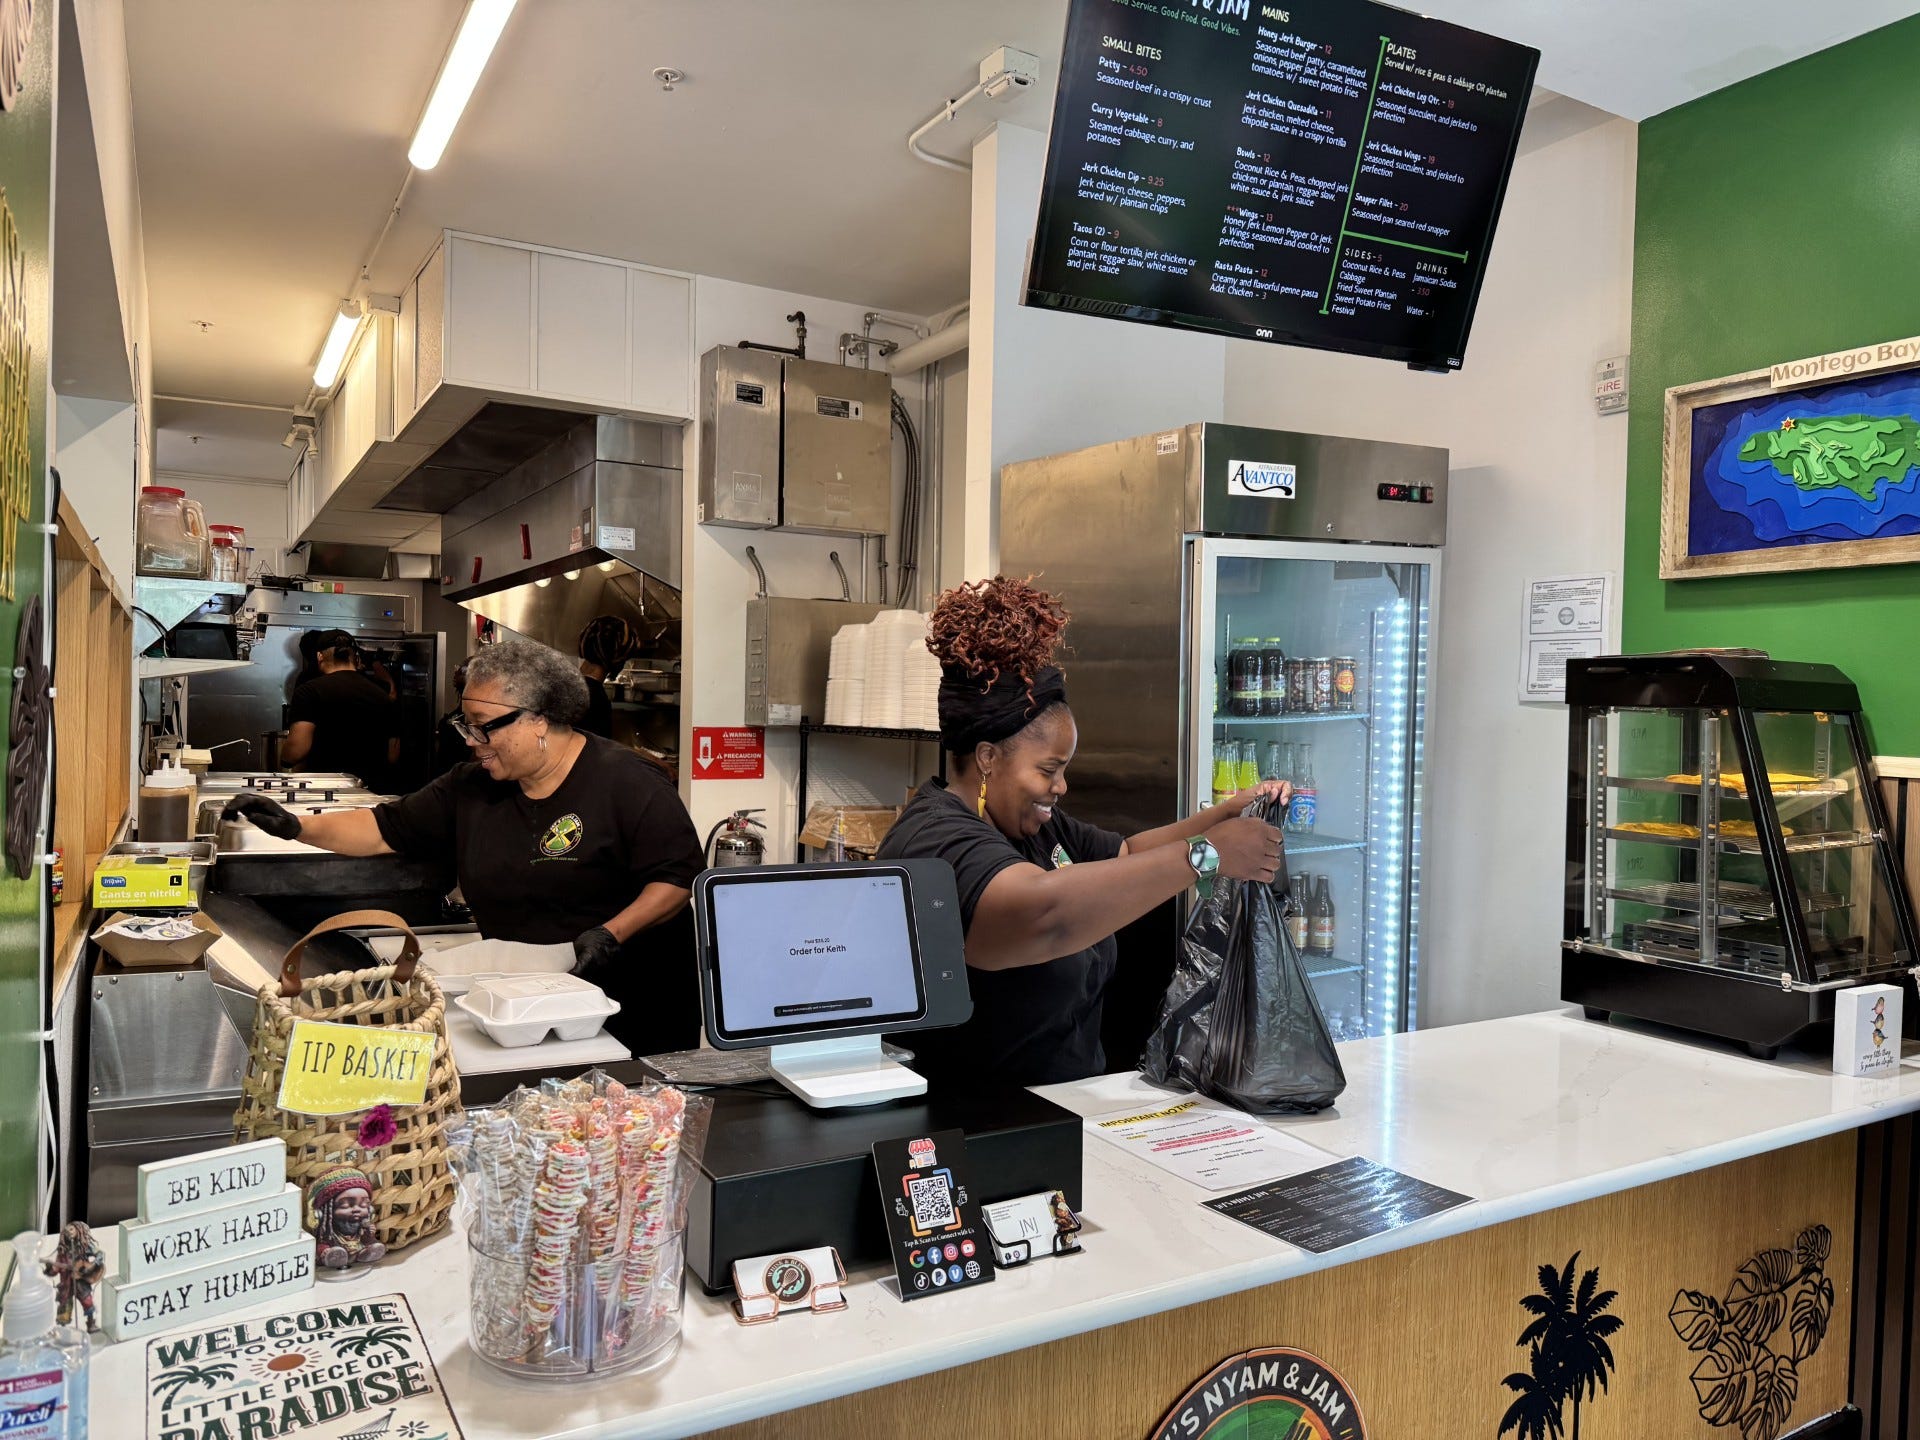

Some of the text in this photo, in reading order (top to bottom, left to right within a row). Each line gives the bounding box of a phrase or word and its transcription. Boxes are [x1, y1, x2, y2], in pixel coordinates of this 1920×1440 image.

[1161, 6, 1179, 20] Good
[1181, 10, 1198, 24] Food.
[1201, 16, 1220, 30] Good
[1221, 22, 1240, 36] Vibes.
[1261, 6, 1290, 23] MAINS
[1102, 36, 1162, 61] SMALL BITES
[1258, 26, 1278, 42] Honey
[1278, 32, 1294, 44] Jerk
[1295, 36, 1318, 51] Burger
[1386, 43, 1417, 60] PLATES
[1098, 56, 1148, 76] Patty 4.50
[1096, 72, 1212, 108] Seasoned beef in a crispy crust
[1245, 90, 1261, 101] Jerk
[1262, 93, 1286, 108] Chicken
[1091, 102, 1114, 118] Curry
[1115, 107, 1149, 124] Vegetable
[1086, 132, 1121, 146] potatoes
[1089, 118, 1195, 151] Steamed cabbage, curry, and
[1236, 146, 1271, 162] Bowls 12
[1366, 140, 1380, 151] Jerk
[1380, 143, 1403, 157] Chicken
[1404, 149, 1421, 162] Wings
[1082, 162, 1164, 187] Jerk Chicken Dip 9.25
[1077, 189, 1168, 214] served w/ plantain chips
[1079, 176, 1186, 207] Jerk chicken, cheese, peppers,
[1354, 192, 1378, 206] Snapper
[1399, 202, 1409, 211] 20
[1072, 221, 1120, 239] Tacos (2) 9
[1351, 208, 1451, 236] Seasoned pan seared red snapper
[1068, 246, 1188, 276] plantain, reggae slaw, white sauce
[1070, 236, 1089, 247] Corn
[1101, 241, 1118, 252] flour
[1120, 246, 1143, 258] tortilla,
[1144, 249, 1159, 260] jerk
[1160, 252, 1187, 265] chicken
[1188, 258, 1197, 267] or
[1066, 259, 1120, 275] and jerk sauce
[1214, 260, 1268, 277] Rasta Pasta 12
[1339, 271, 1366, 284] Cabbage
[1416, 261, 1448, 275] DRINKS
[1336, 282, 1398, 300] Fried Sweet Plantain
[1412, 273, 1457, 289] Jamaican Sodas
[1331, 304, 1356, 316] Festival
[1334, 293, 1392, 311] Sweet Potato Fries
[1772, 342, 1920, 382] Montego Bay
[1597, 380, 1621, 393] FIRE
[100, 890, 131, 899] Gants
[150, 888, 181, 897] nitrile
[790, 945, 846, 956] Order for Keith
[302, 1041, 420, 1080] TIP BASKET
[1098, 1112, 1162, 1128] IMPORTANT
[1162, 1101, 1200, 1117] NOTICE
[168, 1162, 266, 1206] BE KIND
[143, 1208, 288, 1264] WORK HARD
[937, 1232, 957, 1240] Connect
[123, 1254, 309, 1326] STAY HUMBLE
[155, 1302, 402, 1370] WELCOME
[228, 1331, 337, 1360] TO OUR
[162, 1351, 394, 1428] LITTLE PIECE OF
[1202, 1361, 1280, 1416] NYAM
[1283, 1363, 1300, 1390] &
[1301, 1372, 1346, 1426] JAM
